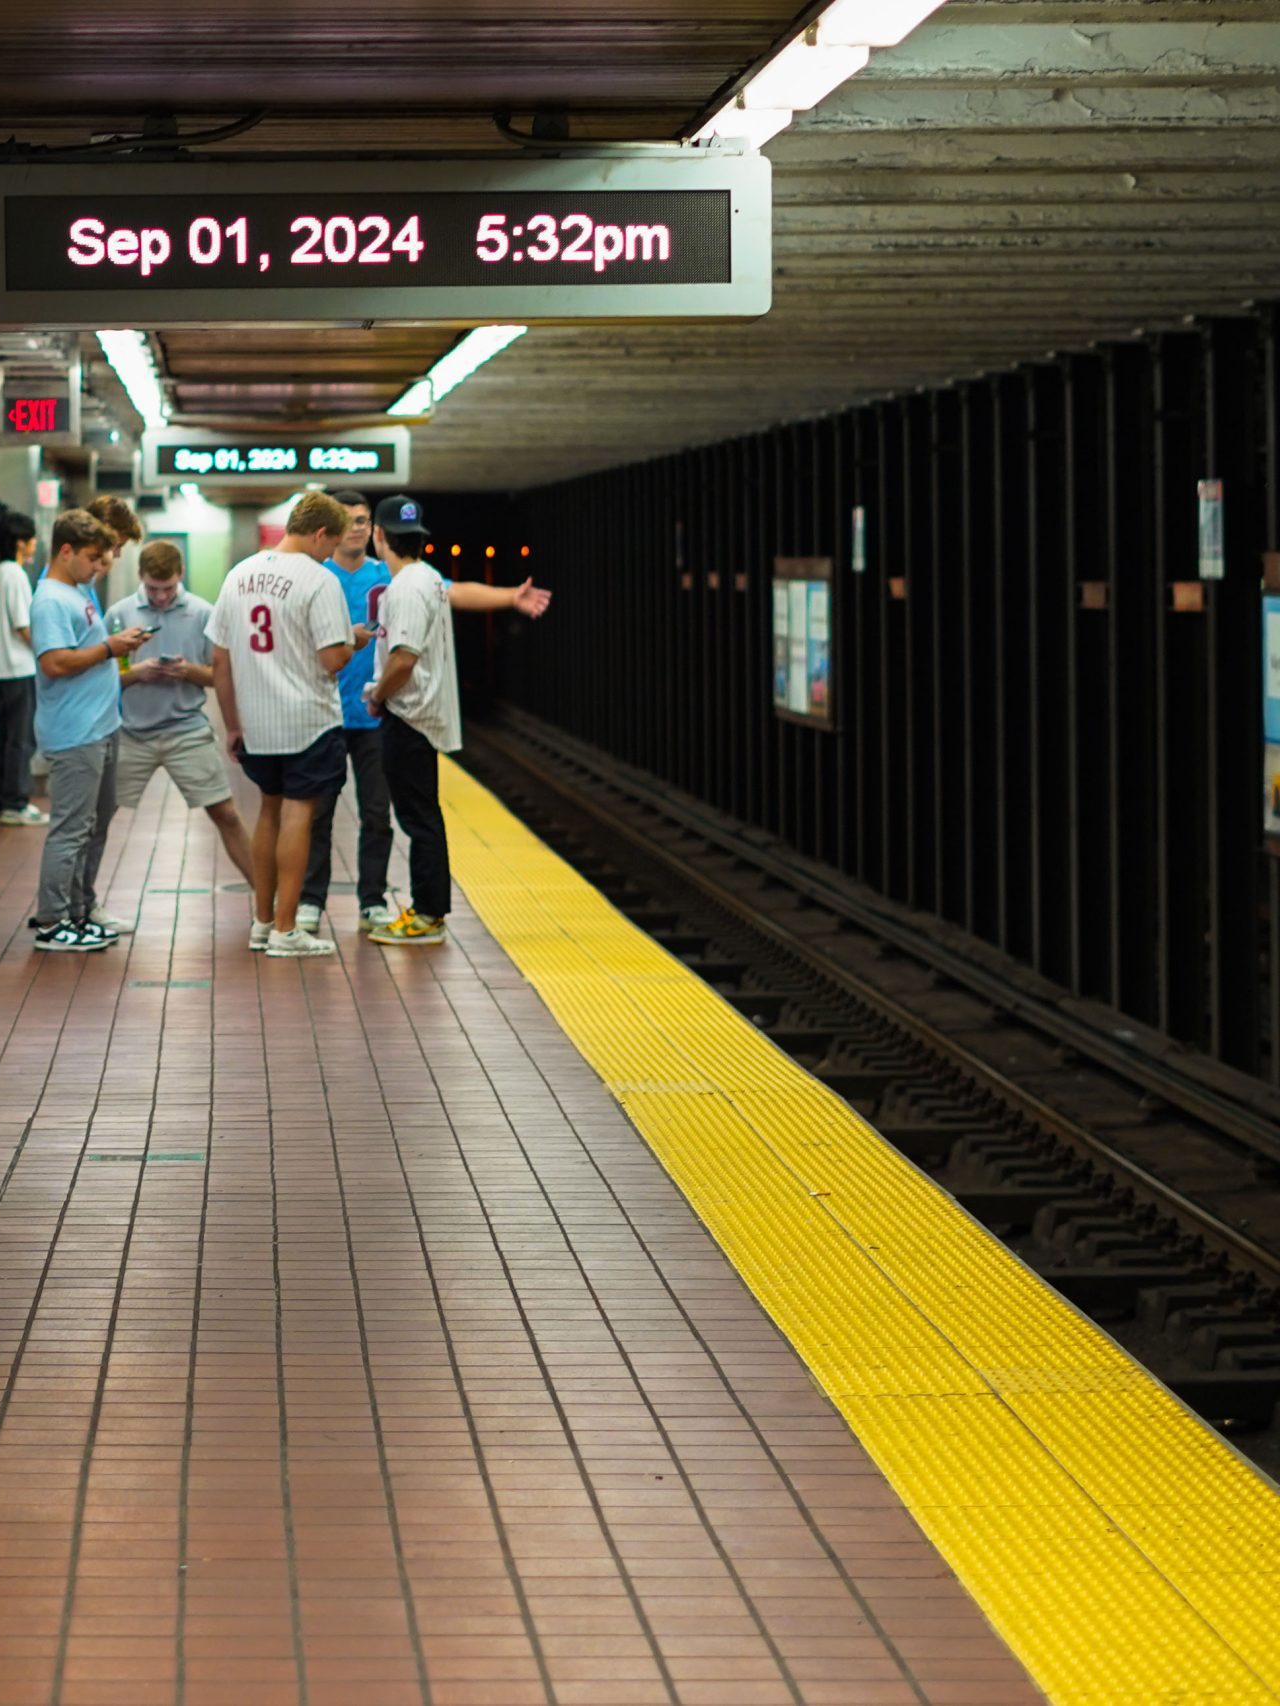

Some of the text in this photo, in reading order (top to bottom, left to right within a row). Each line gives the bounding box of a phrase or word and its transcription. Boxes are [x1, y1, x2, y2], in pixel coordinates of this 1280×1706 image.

[67, 214, 671, 277] Sep 01, 2024 5:32pm
[15, 399, 58, 431] EXIT
[238, 573, 294, 600] HARPER
[250, 604, 274, 653] 3
